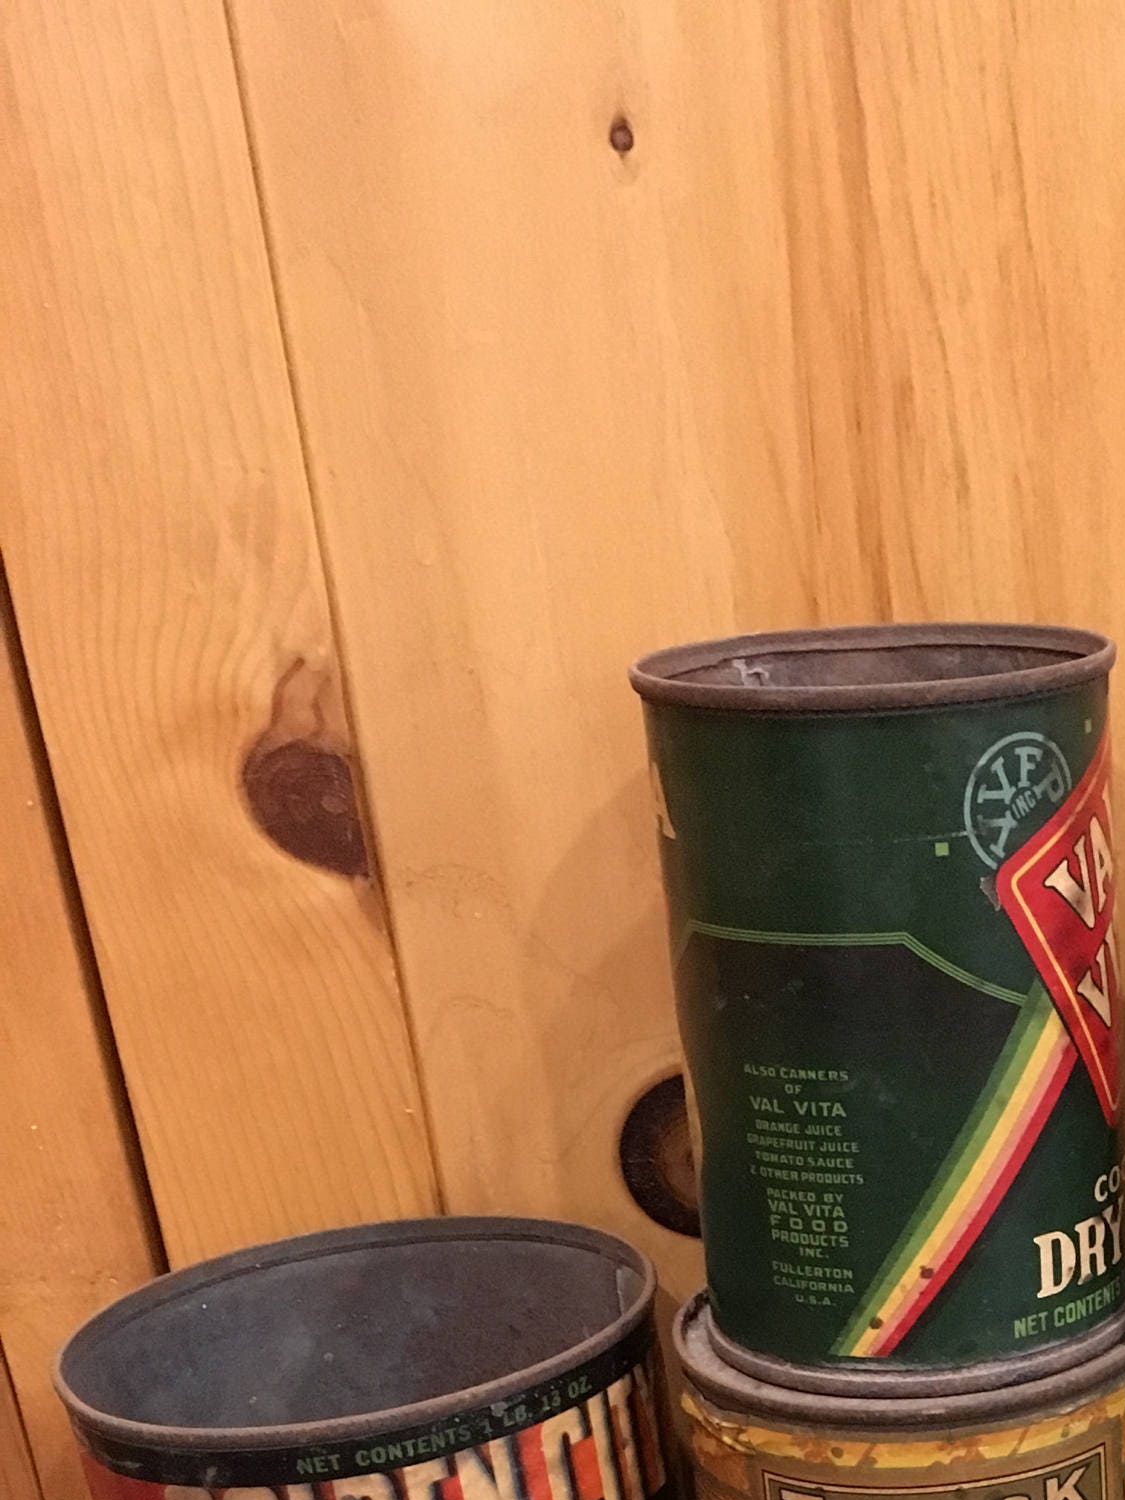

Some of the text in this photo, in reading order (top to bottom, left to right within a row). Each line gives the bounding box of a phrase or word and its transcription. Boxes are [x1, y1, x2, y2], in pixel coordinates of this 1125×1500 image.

[743, 1064, 849, 1082] ALSO CANNERS
[784, 1083, 803, 1095] OF
[749, 1095, 847, 1118] VAL VITA
[755, 1119, 842, 1137] ORANGE JUICE
[746, 1132, 860, 1154] GRAPEFRUIT JUICE
[754, 1149, 855, 1170] TOMATO SAUCE
[759, 1168, 865, 1186] OTHER PRODUCTS
[766, 1187, 845, 1204] PACKED BY
[767, 1198, 846, 1219] VAL VITA
[769, 1214, 849, 1234] FOOD
[771, 1228, 850, 1249] PRODUCTS
[1032, 1195, 1122, 1299] DRY
[771, 1259, 853, 1281] FULLERTON
[772, 1274, 856, 1295] CALIFORNIA
[1013, 1310, 1049, 1339] NET
[296, 1453, 342, 1477] NET
[354, 1426, 472, 1469] CONTENTS
[482, 1419, 495, 1436] 1
[541, 1393, 564, 1413] 13
